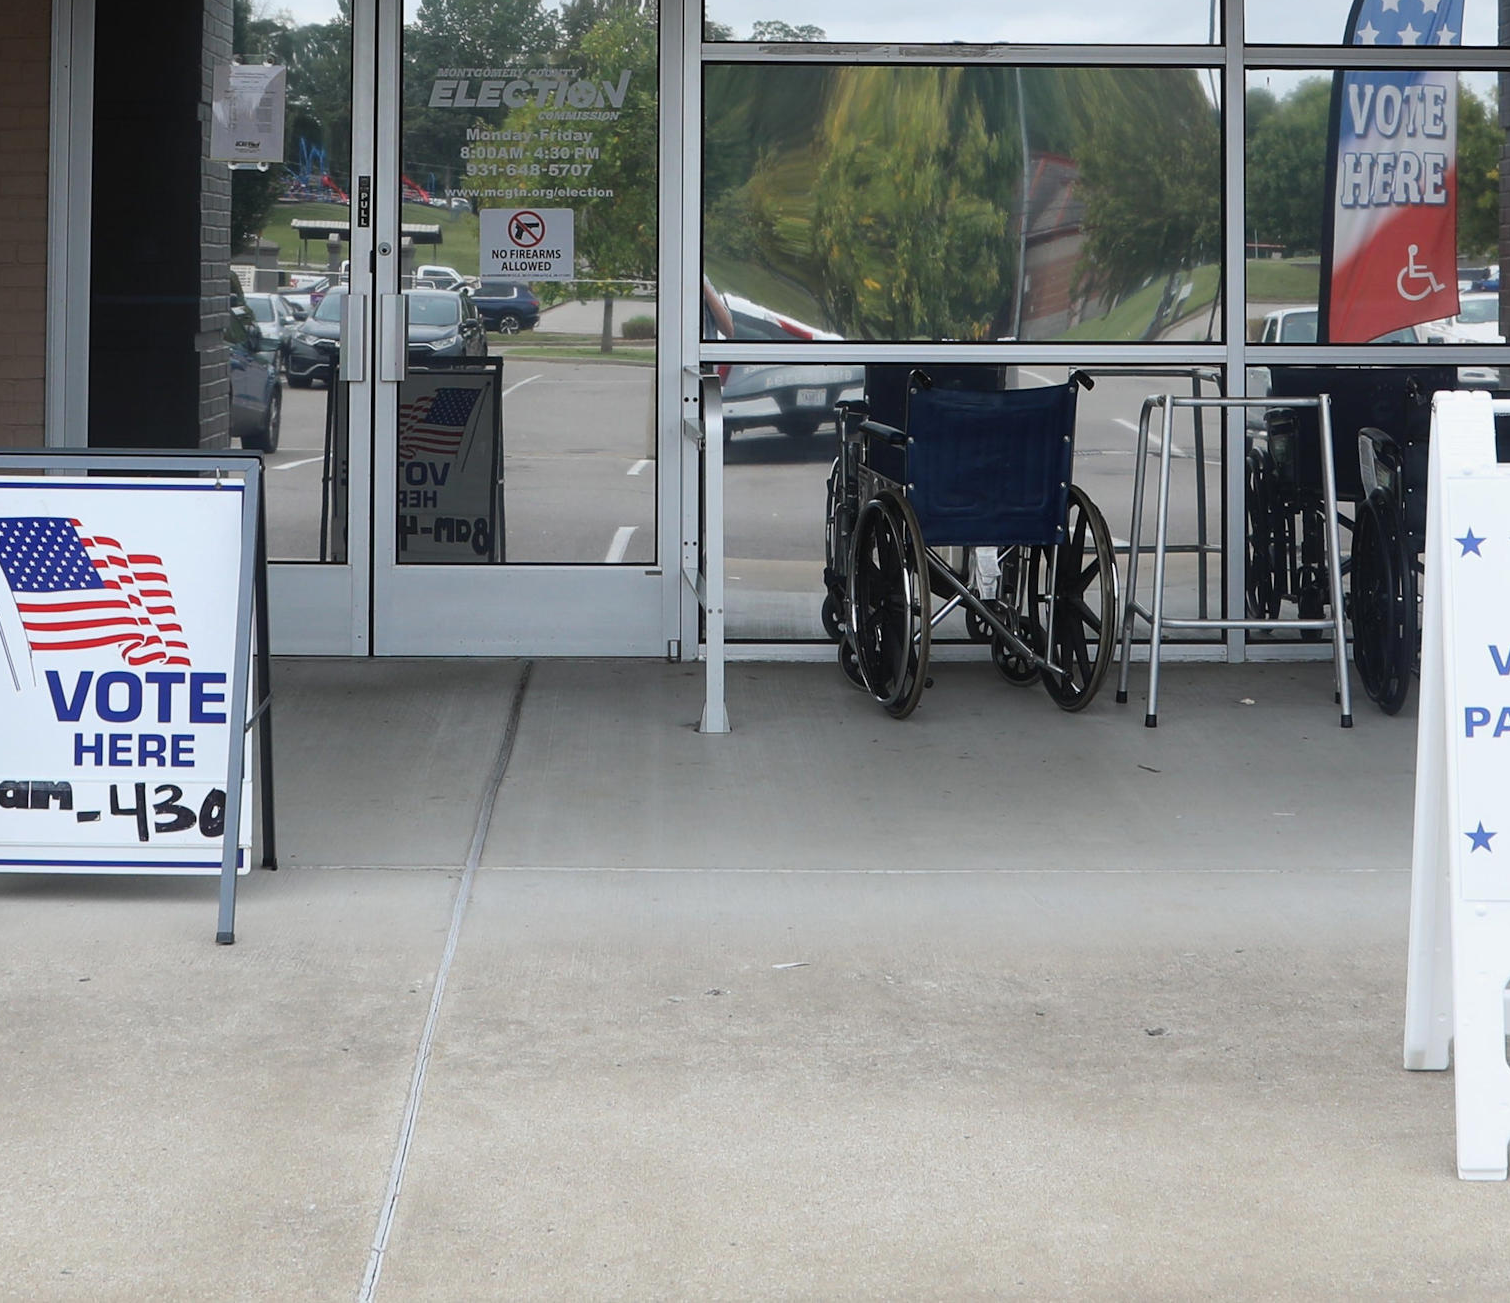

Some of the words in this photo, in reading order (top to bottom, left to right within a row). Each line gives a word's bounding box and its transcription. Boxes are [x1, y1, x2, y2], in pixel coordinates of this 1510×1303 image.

[437, 68, 526, 78] MONTGOMERY
[528, 68, 579, 78] COUNTY
[428, 70, 632, 108] ELECTION
[538, 111, 620, 121] COMMISSION
[1348, 83, 1447, 139] VOTE
[574, 147, 600, 159] PM
[466, 164, 593, 176] 931-648-5707
[1340, 151, 1447, 207] HERE
[444, 187, 614, 199] www.mcgtn.org/election
[360, 192, 368, 226] PULL
[492, 250, 507, 259] NO
[510, 250, 561, 259] FIREARMS
[501, 261, 552, 271] ALLOWED
[45, 670, 227, 724] VOTE
[73, 733, 195, 768] HERE
